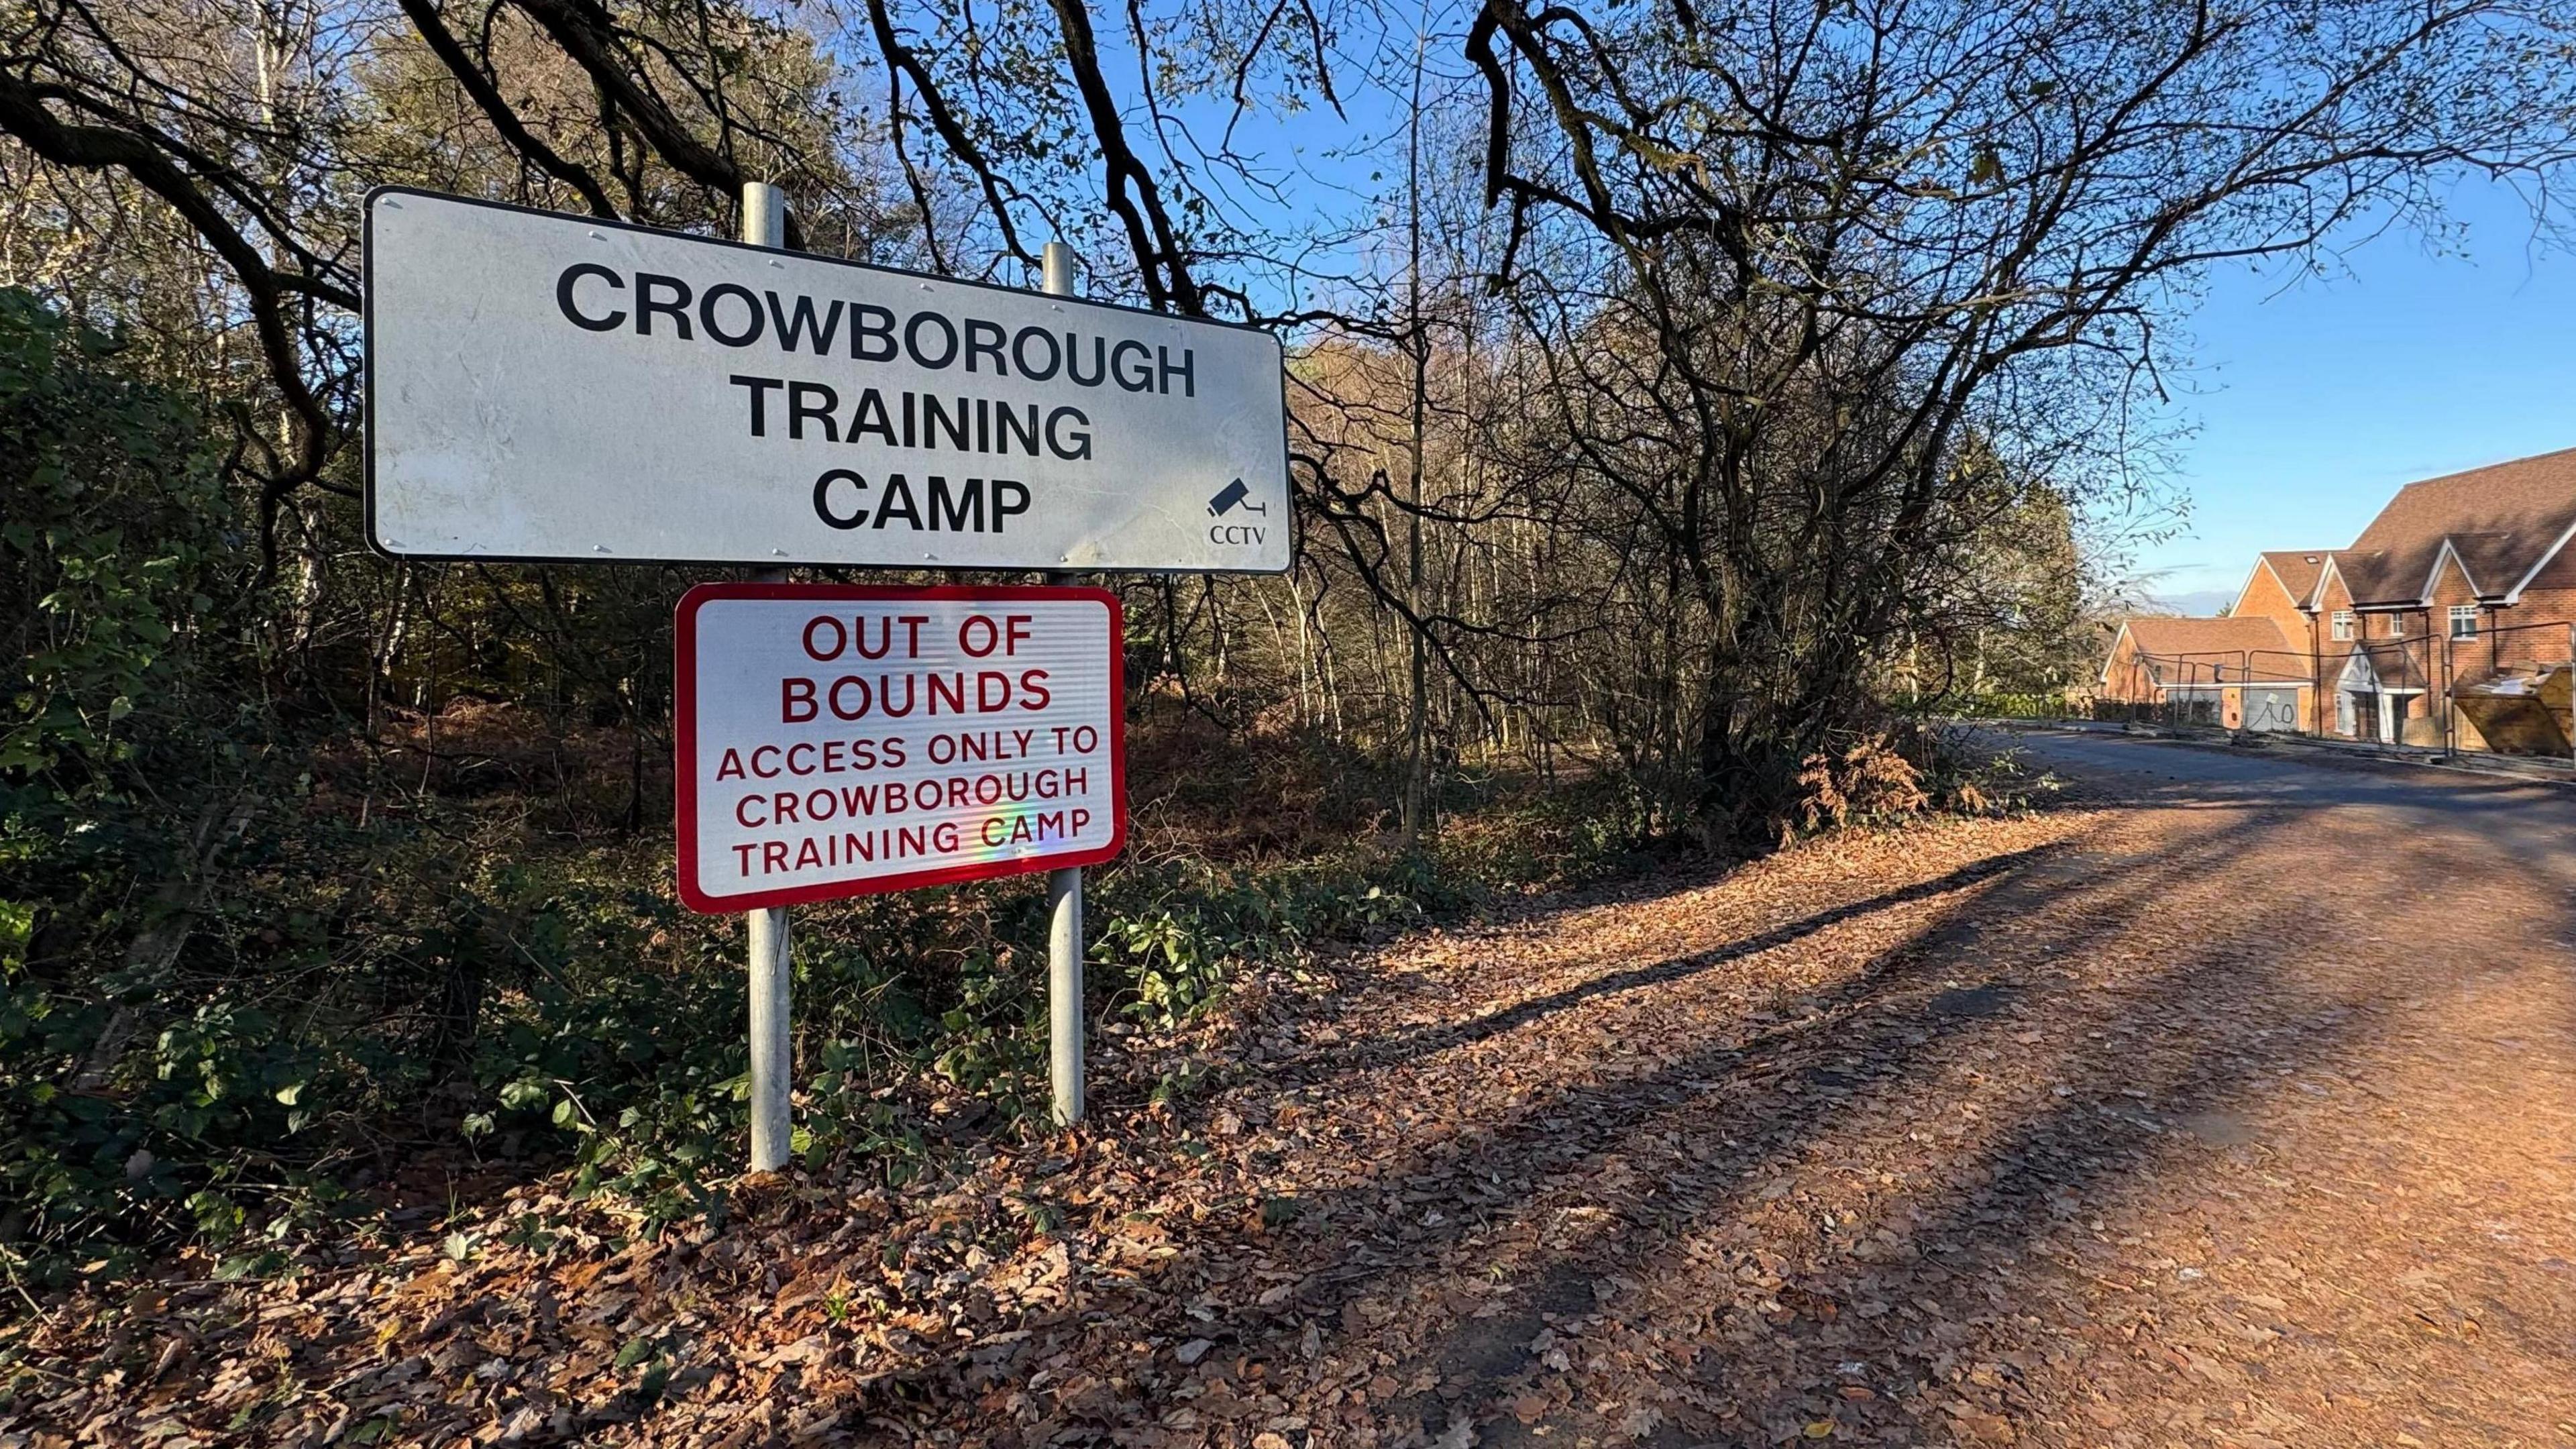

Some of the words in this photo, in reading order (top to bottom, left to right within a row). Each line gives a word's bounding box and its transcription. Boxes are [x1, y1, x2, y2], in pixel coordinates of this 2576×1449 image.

[557, 263, 1195, 398] CROWBOROUGH
[730, 374, 1092, 461] TRAINING
[813, 469, 1032, 534] CAMP
[1210, 525, 1266, 545] CCTV
[802, 616, 930, 662] OUT
[959, 614, 1032, 658] OF
[782, 669, 1051, 724] BOUNDS
[716, 737, 906, 782] ACCESS
[928, 729, 1034, 765] ONLY
[1051, 725, 1098, 755] TO
[736, 767, 1087, 828] CROWBOROUGH
[732, 822, 959, 877] TRAINING
[981, 808, 1091, 847] CAMP
